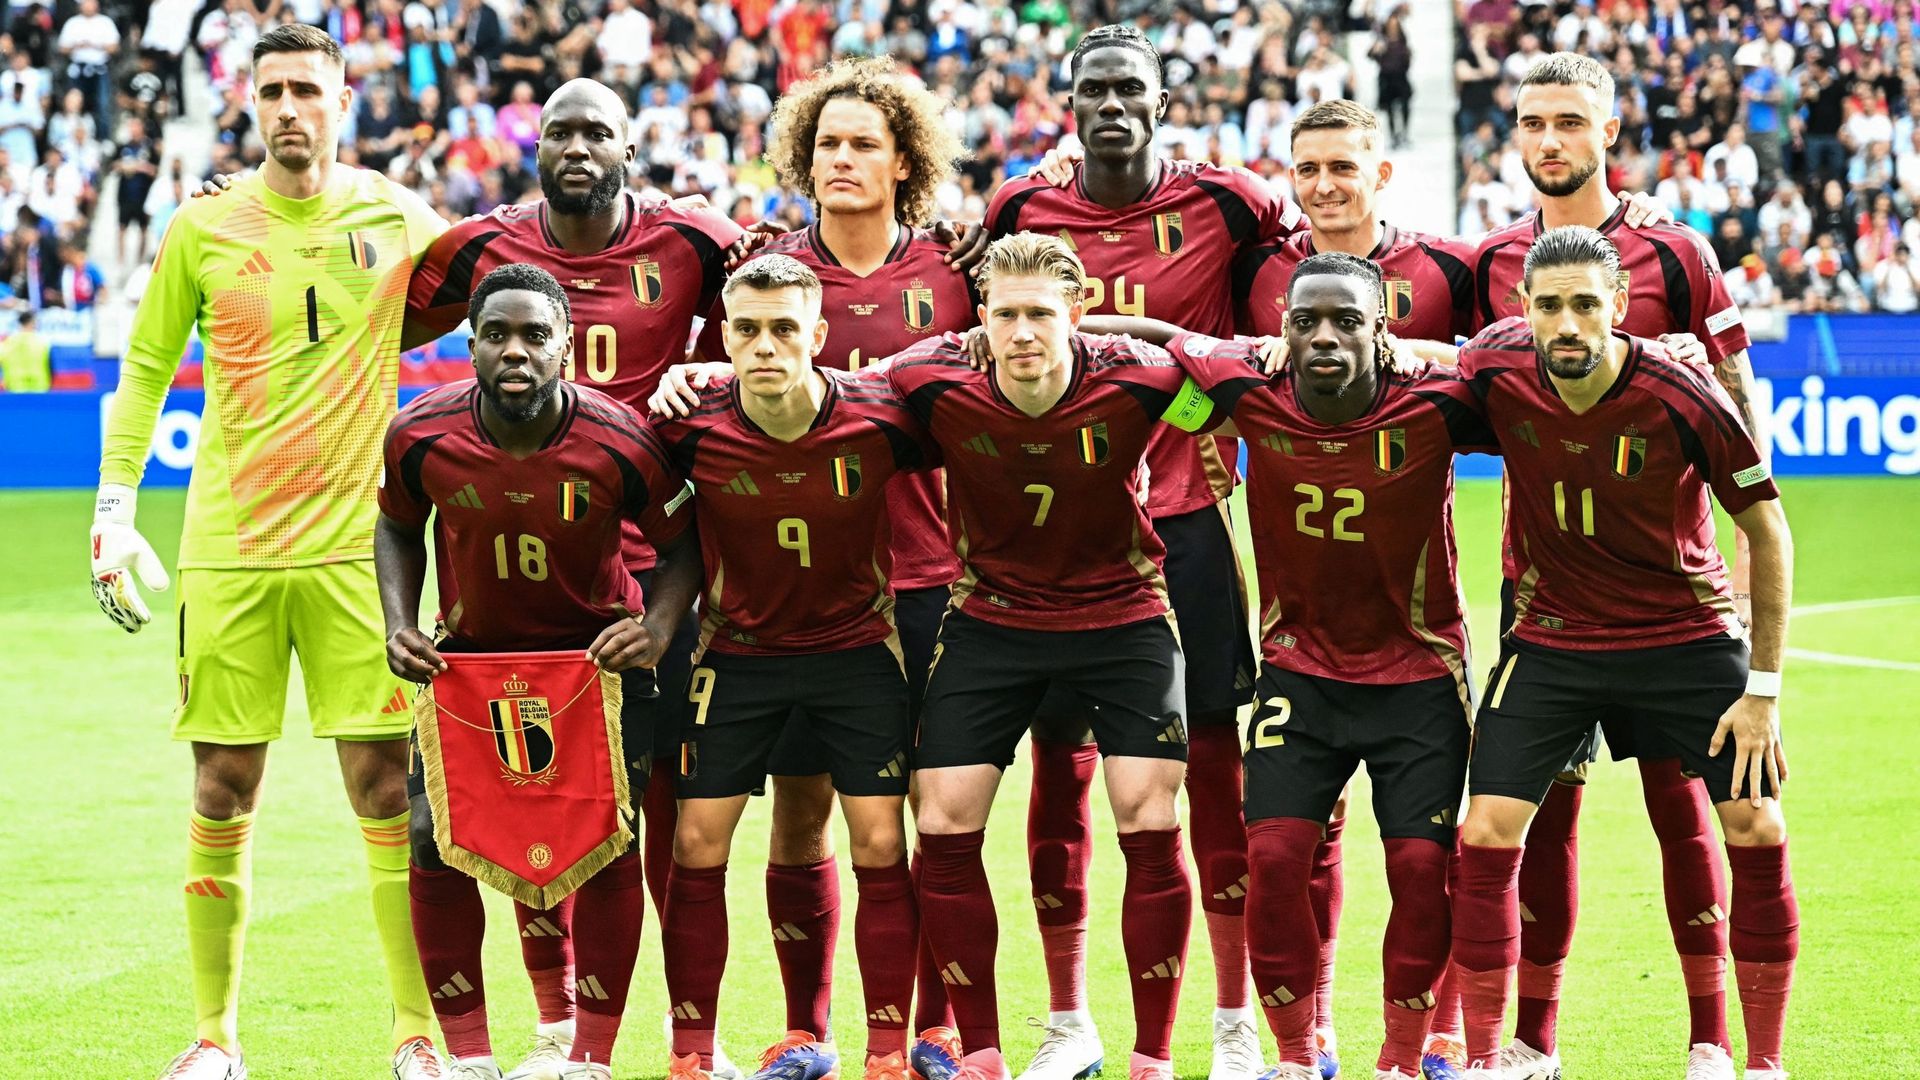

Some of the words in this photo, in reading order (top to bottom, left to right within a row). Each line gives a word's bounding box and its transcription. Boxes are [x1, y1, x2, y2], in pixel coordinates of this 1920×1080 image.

[306, 285, 320, 343] 1
[563, 323, 617, 383] 10
[1023, 484, 1055, 527] 7
[1294, 483, 1365, 542] 22
[1554, 481, 1595, 536] 11
[494, 533, 548, 581] 18
[777, 518, 811, 568] 9
[689, 667, 716, 725] 9
